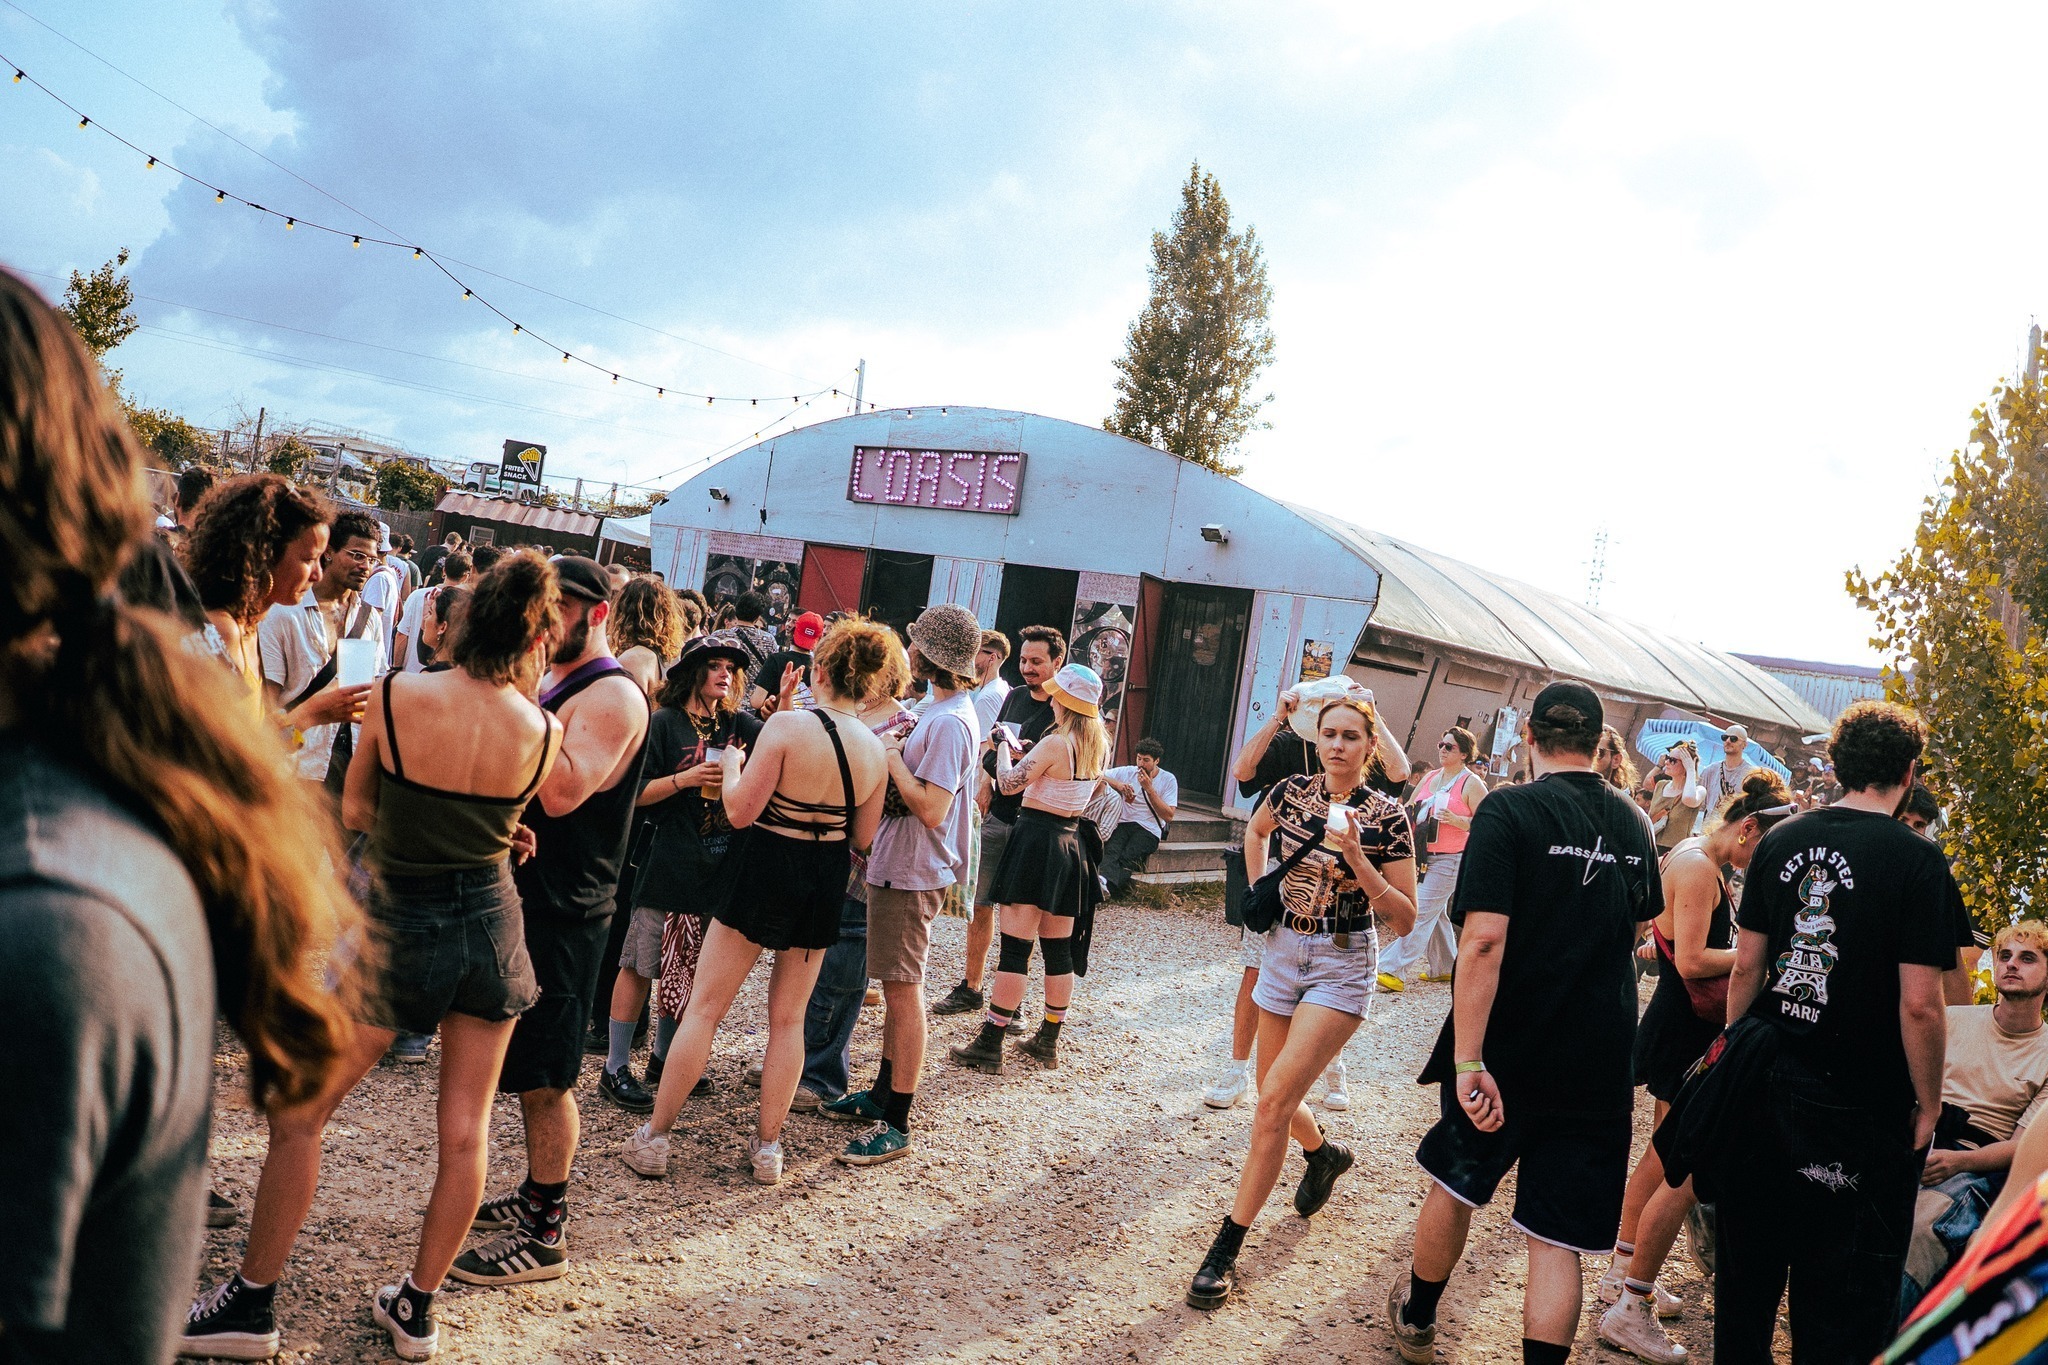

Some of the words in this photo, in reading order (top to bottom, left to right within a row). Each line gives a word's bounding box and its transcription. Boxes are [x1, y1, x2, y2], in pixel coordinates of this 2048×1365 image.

[503, 471, 527, 480] SNACK
[504, 464, 525, 473] FRITES
[852, 448, 1020, 510] L'OASIS
[702, 834, 731, 846] LONDO
[1548, 845, 1641, 866] BASSIMPCT
[1779, 852, 1804, 883] GET
[1809, 847, 1827, 861] IN
[1828, 851, 1855, 890] STEP
[1781, 1000, 1821, 1023] PARIS
